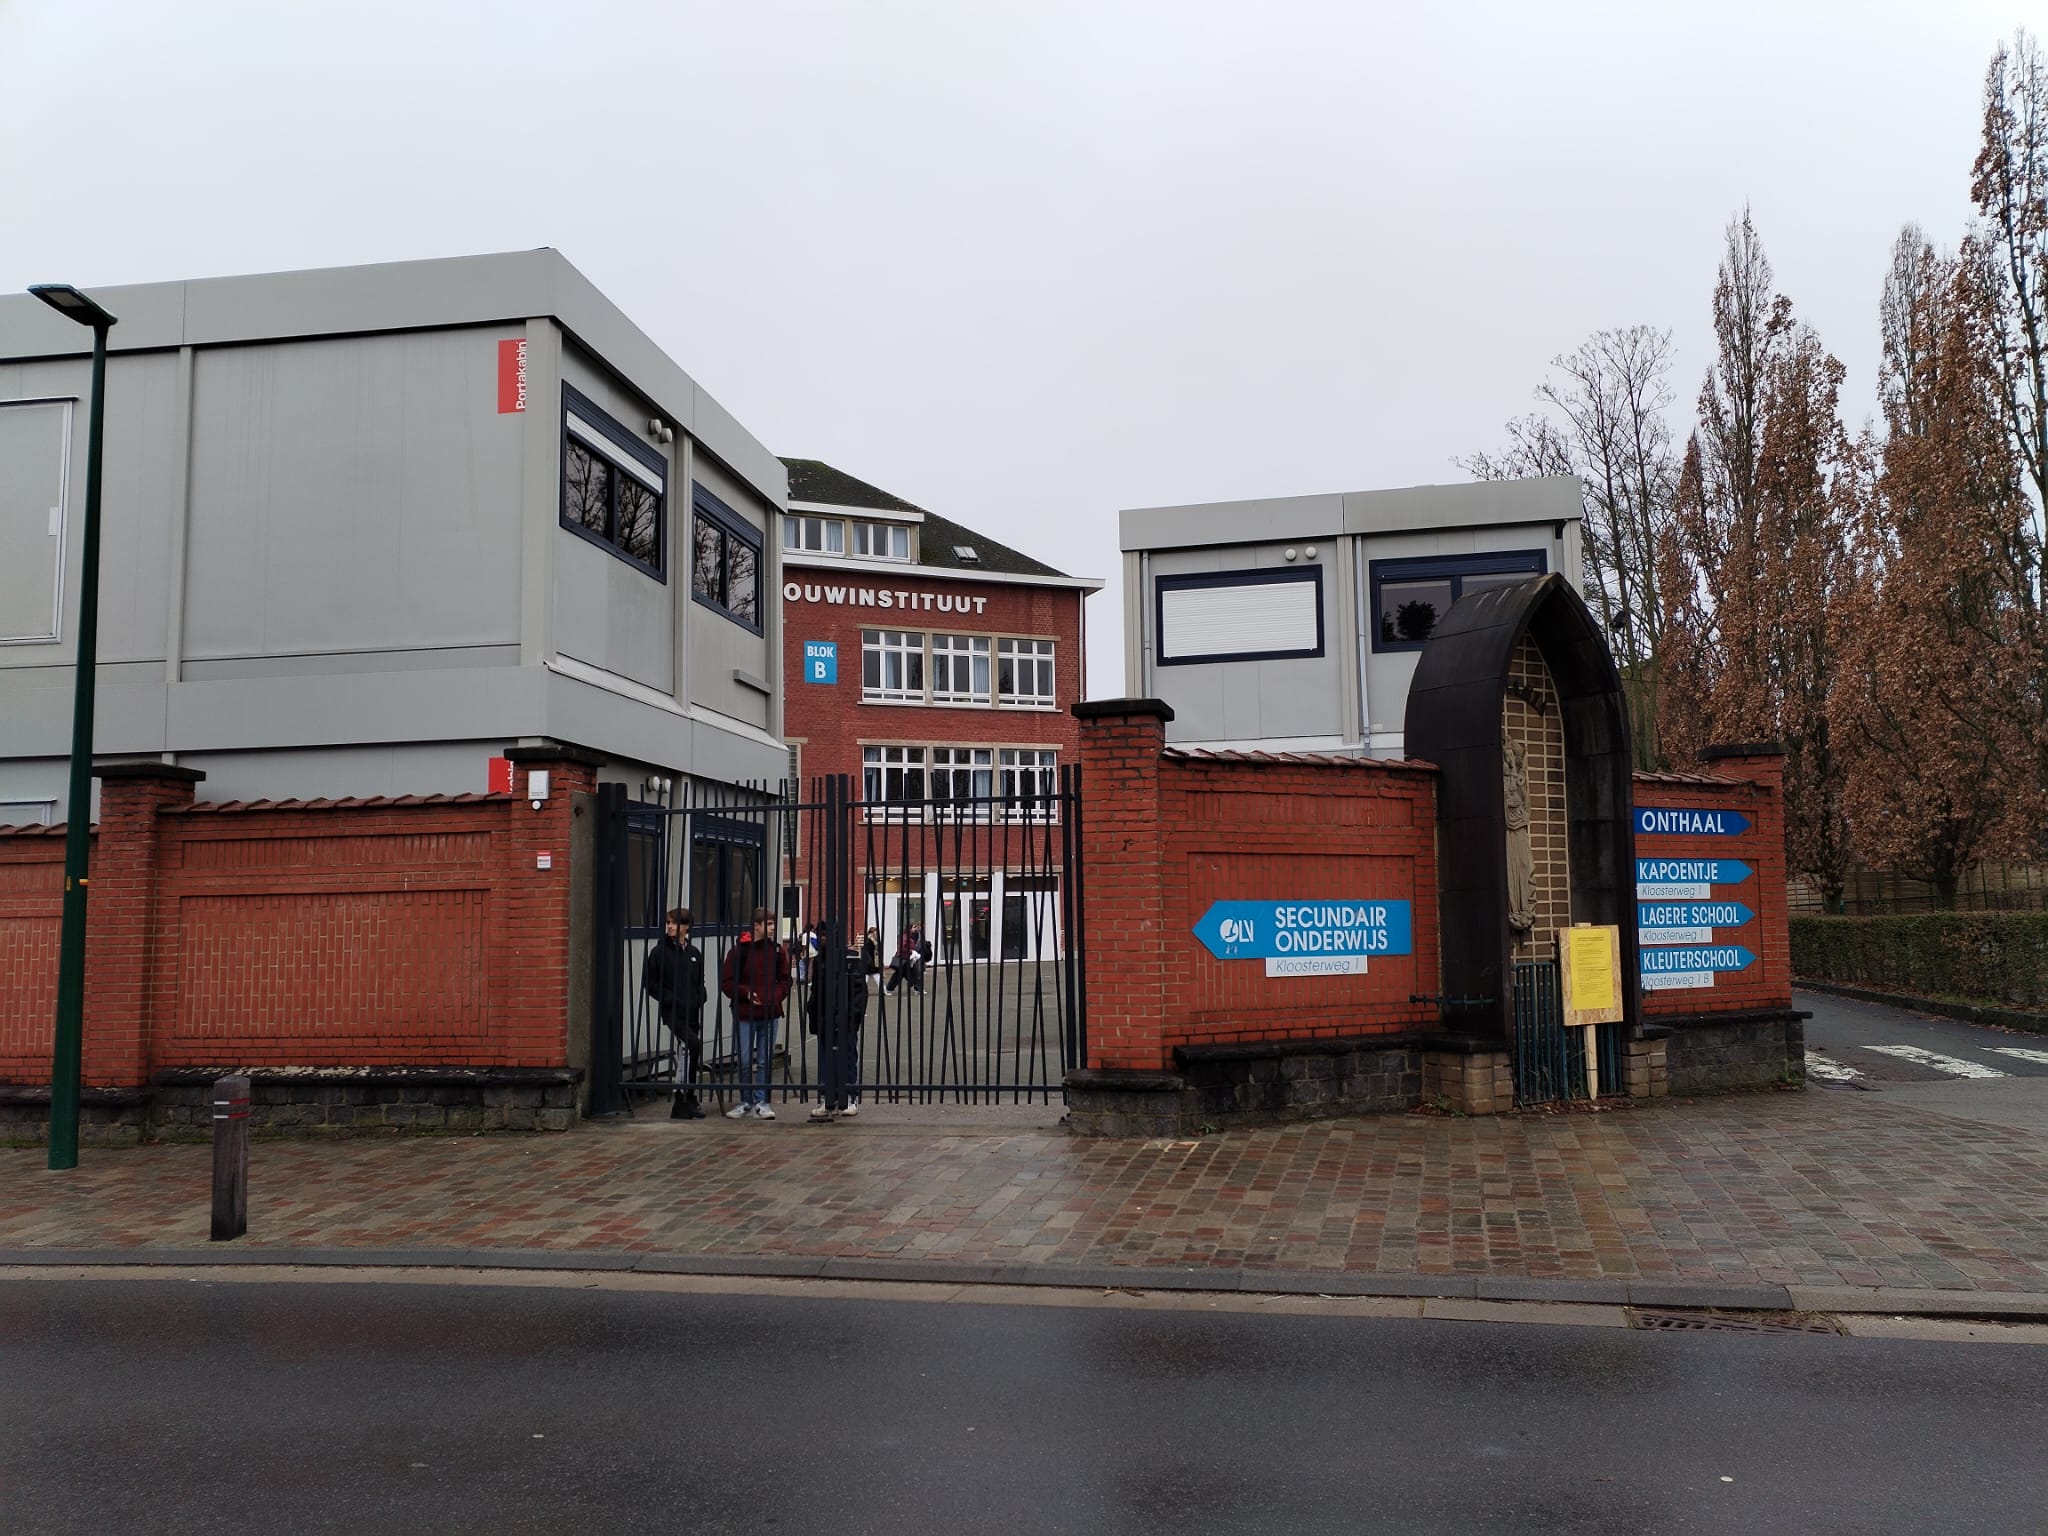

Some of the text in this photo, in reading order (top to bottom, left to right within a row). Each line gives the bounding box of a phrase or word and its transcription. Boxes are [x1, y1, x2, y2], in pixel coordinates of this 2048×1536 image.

[515, 341, 527, 410] Portakabin
[783, 582, 987, 614] OUWINSTITUUT
[807, 645, 834, 659] BLOK
[814, 661, 827, 679] B
[1641, 811, 1725, 833] ONTHAAL
[1639, 862, 1718, 880] KAPOENTJE
[1642, 885, 1695, 898] Kloosterweg
[1274, 906, 1387, 928] SECUNDAIR
[1642, 906, 1740, 925] LAGERE SCHOOL
[1274, 929, 1388, 952] ONDERWIJS
[1644, 929, 1697, 943] Kloosterweg
[1276, 957, 1360, 974] Kloosterweg 1
[1643, 949, 1741, 970] KLEUTERSCHOOL
